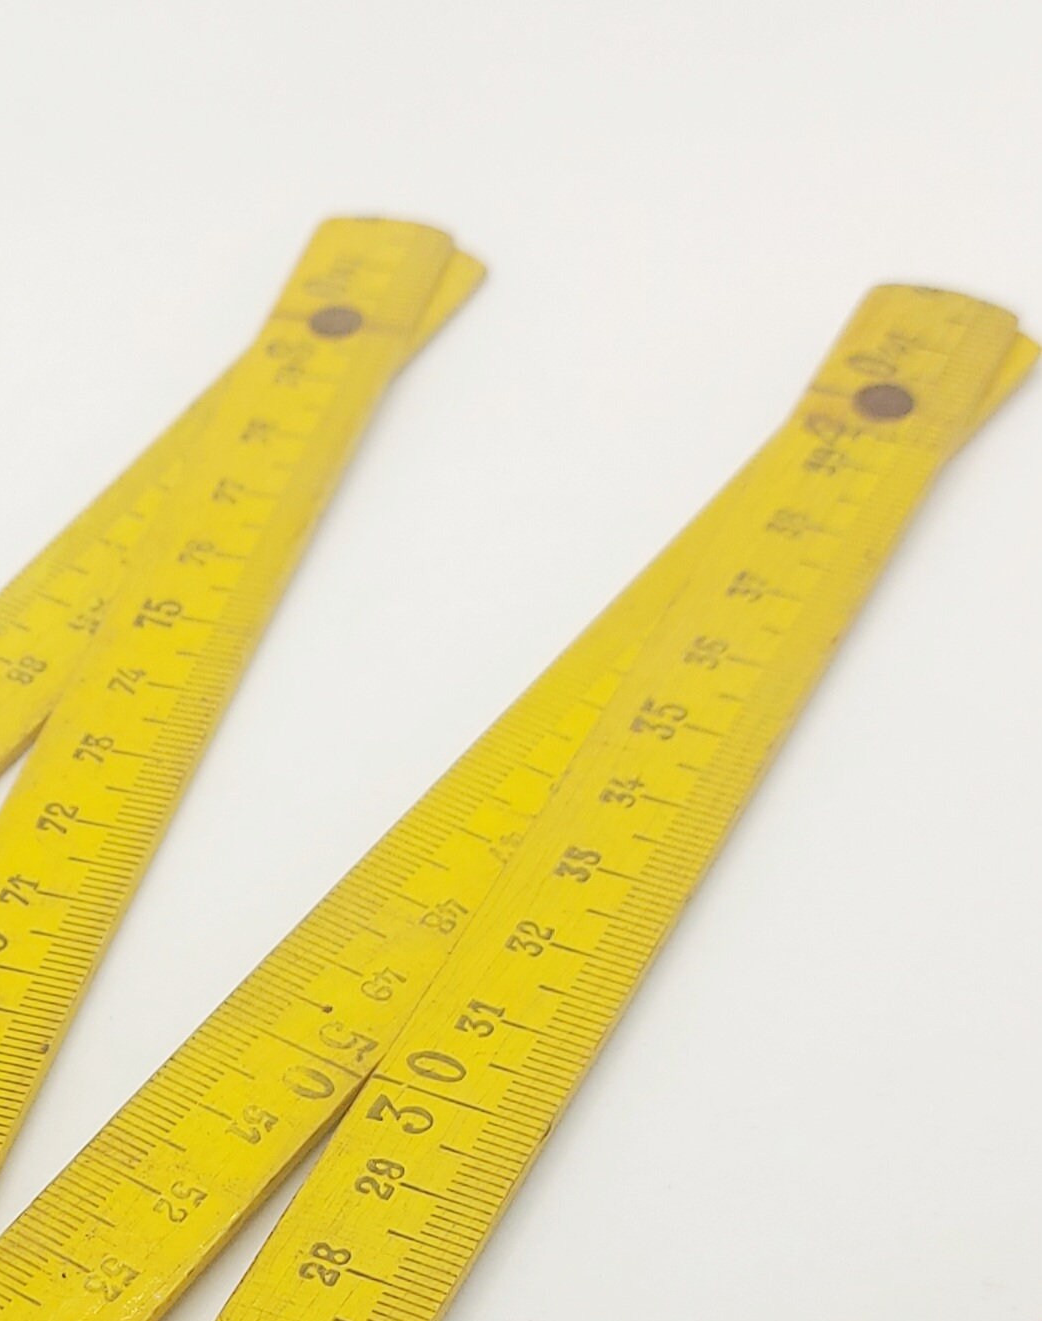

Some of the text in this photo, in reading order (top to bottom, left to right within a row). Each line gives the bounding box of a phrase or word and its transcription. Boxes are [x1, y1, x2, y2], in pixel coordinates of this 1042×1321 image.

[36, 803, 79, 833] 72
[108, 668, 147, 694] 74
[134, 598, 182, 628] 75
[299, 1242, 351, 1287] 28
[366, 1051, 466, 1134] 30
[454, 999, 505, 1038] 31
[505, 920, 555, 957] 32
[600, 778, 645, 809] 34
[630, 696, 688, 741] 35
[282, 1022, 379, 1100] 50
[226, 1104, 279, 1145] 51
[153, 1181, 207, 1223] 52
